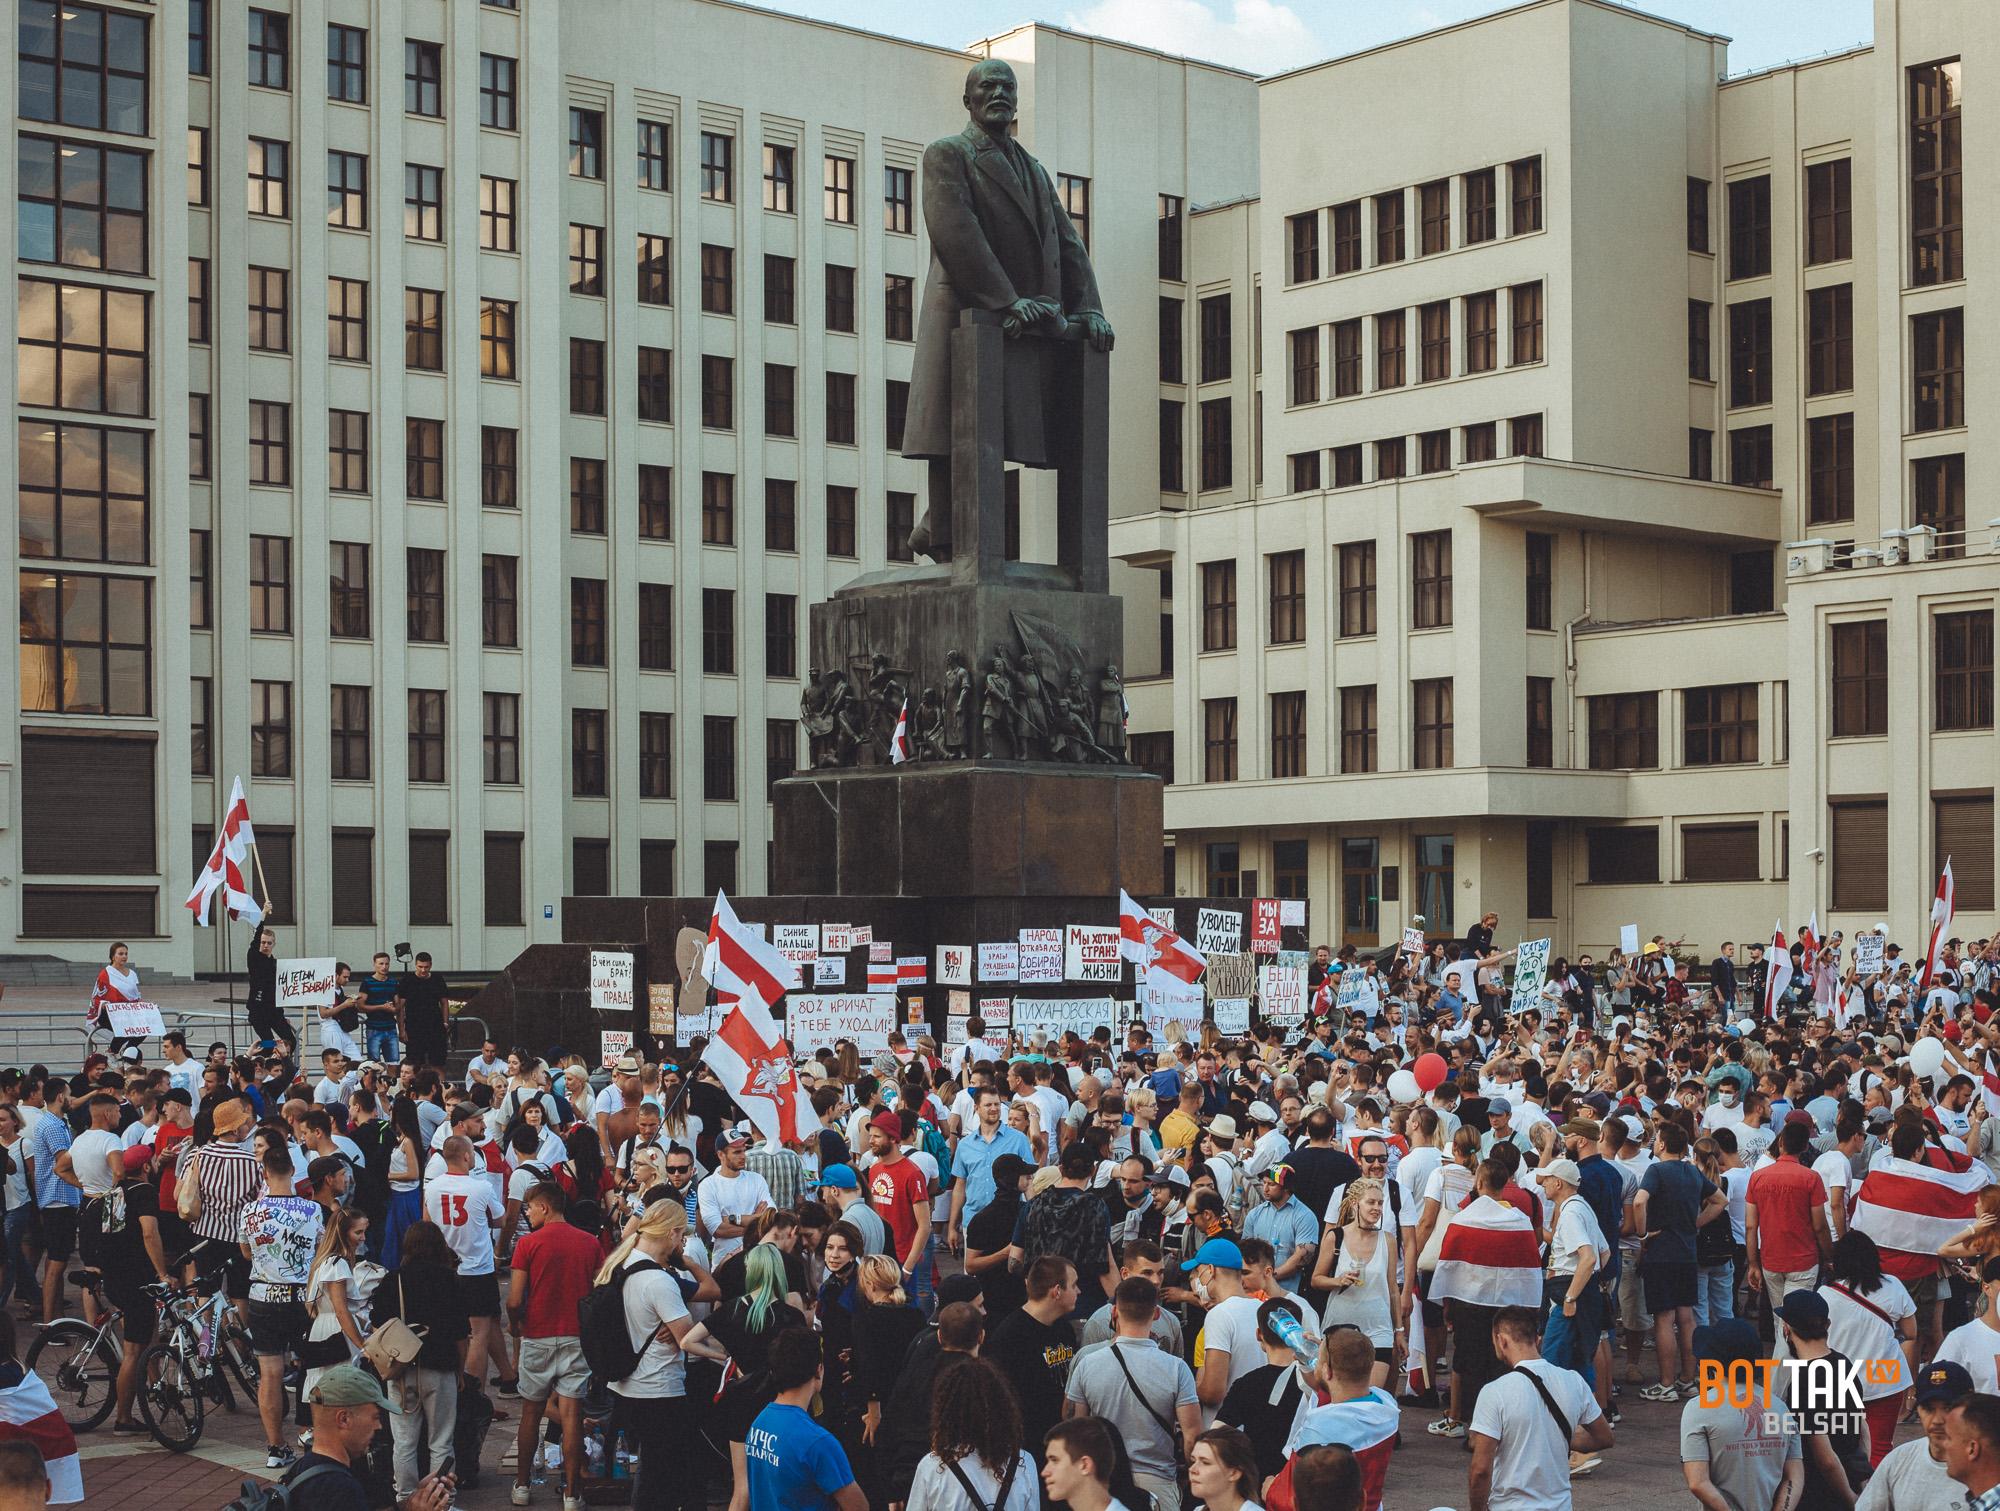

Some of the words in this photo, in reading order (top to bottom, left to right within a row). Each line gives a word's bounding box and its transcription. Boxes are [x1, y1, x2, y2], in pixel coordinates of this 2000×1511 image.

[1258, 902, 1277, 918] МЫ
[783, 928, 809, 937] СИНИЕ
[1258, 918, 1276, 936] ЗА
[777, 939, 814, 949] ПАЛЬЦЫ
[828, 936, 848, 949] НЕТ!
[1026, 930, 1058, 943] НАРОД
[1081, 945, 1117, 958] СТРАНУ
[1519, 938, 1550, 959] УСАТЫЙ
[1020, 955, 1061, 969] СОБИРАЙ
[944, 965, 961, 979] 97%
[1020, 968, 1063, 979] ПОРТФЕЛЬ
[1081, 964, 1119, 979] ЖИЗНИ
[1268, 967, 1300, 982] БЕГИ
[1215, 978, 1251, 997] ЛЮДИ
[1266, 983, 1300, 998] САША
[603, 991, 633, 1005] ПРАВДЕ
[1512, 995, 1540, 1013] ВИРУС
[798, 999, 824, 1014] 80%
[830, 998, 877, 1014] КРИЧАТ
[1016, 1001, 1110, 1020] ТИХАНОВСКАЯ
[1268, 999, 1300, 1014] БЕГИ
[801, 1018, 832, 1032] ТЕБЕ
[839, 1017, 887, 1034] УХОДИ!
[605, 1033, 628, 1043] BLOODY
[441, 1194, 469, 1227] 13
[748, 1427, 777, 1453] МЧС
